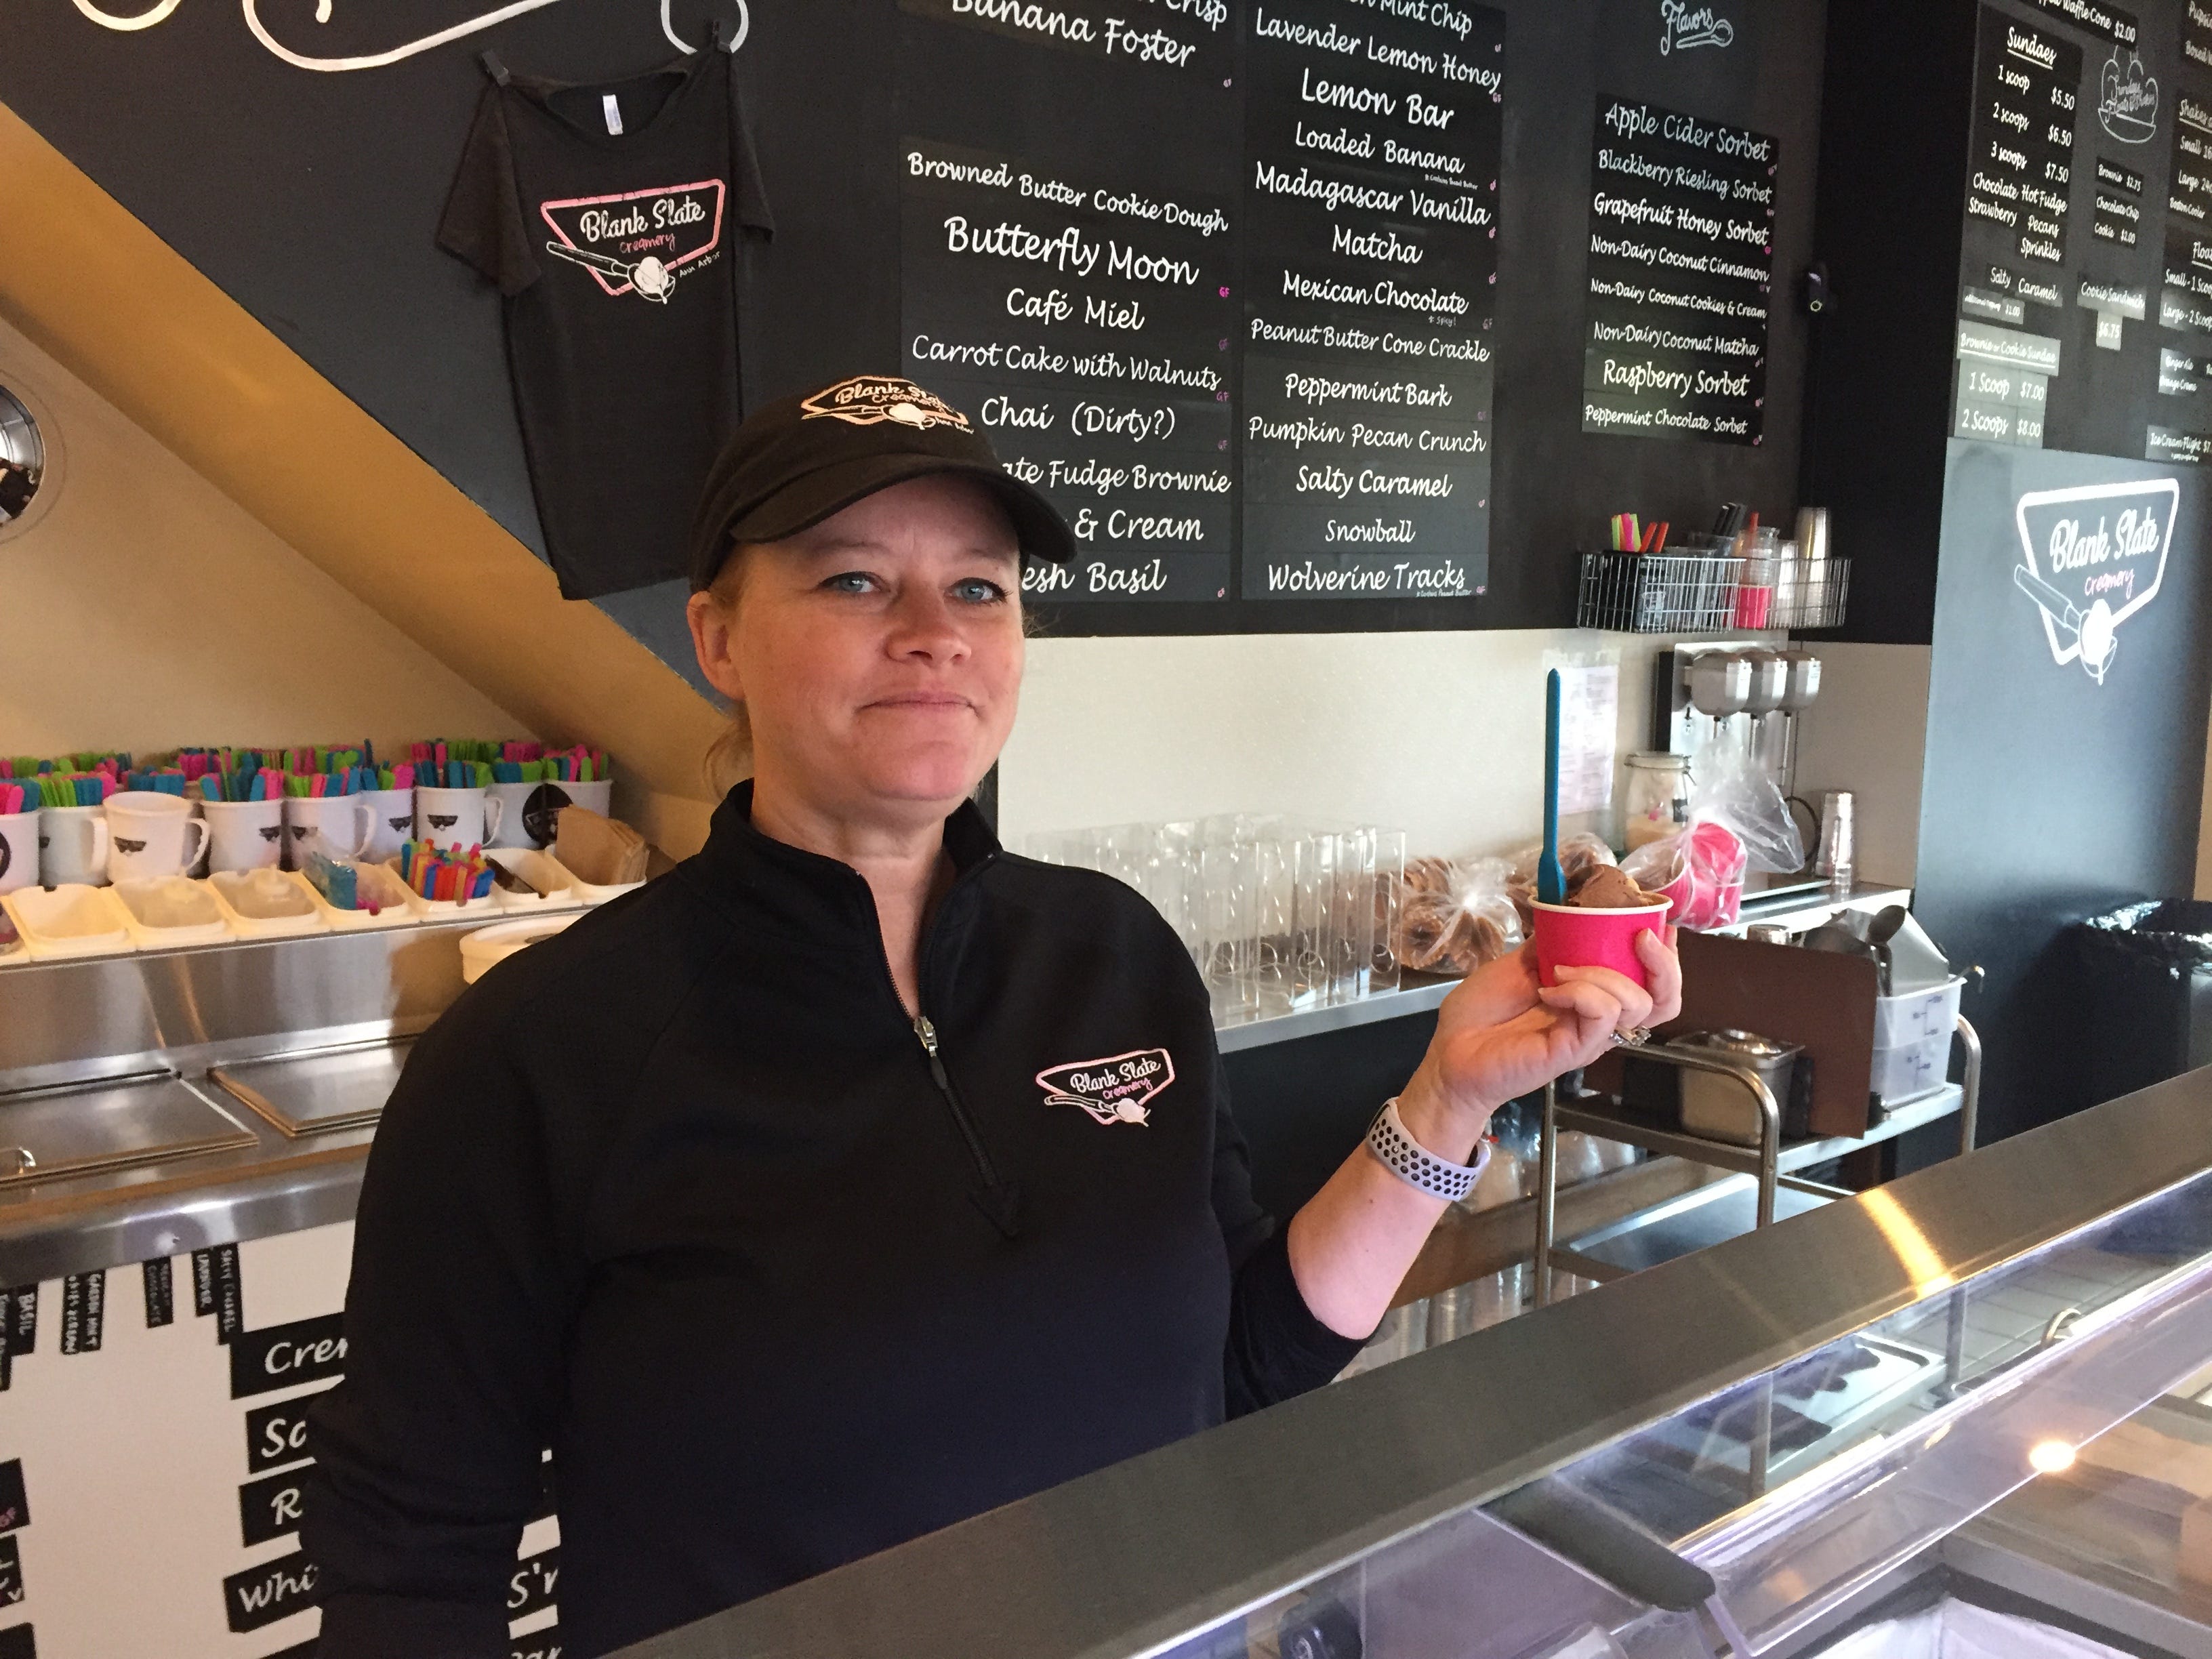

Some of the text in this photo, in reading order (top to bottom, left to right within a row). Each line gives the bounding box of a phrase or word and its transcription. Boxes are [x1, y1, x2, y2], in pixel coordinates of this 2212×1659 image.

[954, 0, 1195, 66] Banana Foster
[1431, 3, 1472, 41] Chip
[1660, 0, 1713, 56] Flavors
[2090, 7, 2112, 30] Cone
[2114, 20, 2135, 43] $2.00
[1256, 7, 1501, 94] Lavender Lemon Honey
[2007, 26, 2057, 64] Sundaes
[1302, 68, 1454, 129] Lemon Bar
[1998, 65, 2004, 81] 1
[2005, 70, 2030, 96] scoop
[2051, 86, 2075, 111] $5.50
[1605, 102, 1771, 162] Apple Cider Sorbet
[1993, 102, 2072, 147] 2 scoops $6.50
[1296, 121, 1465, 174] Loaded Banana
[1990, 142, 2068, 184] 3 scoops $7.50
[2180, 136, 2202, 155] Small
[907, 152, 1228, 237] Browned Butter Cookie Dough
[1256, 161, 1491, 226] Madagascar Vanilla
[1598, 149, 1773, 204] Blackberry Riesling Sorbet
[1973, 172, 2068, 217] Chocolate Hot Fudge
[2178, 169, 2199, 192] Large
[580, 194, 705, 243] Blank Slate
[1594, 192, 1770, 246] Grapefruit Honey Sorbet
[1968, 197, 2060, 239] Strawberry Pecans
[619, 232, 676, 254] creamery
[945, 216, 1199, 285] Butterfly Moon
[1332, 224, 1423, 264] Matcha
[1591, 234, 1769, 283] Non-Dairy Coconut Cinnamon
[2020, 237, 2062, 262] Sprinkles
[1283, 270, 1469, 315] Mexican Chocolate
[1990, 267, 2059, 301] Salty Caramel
[2081, 281, 2108, 302] Cookie
[2165, 268, 2186, 287] Small
[1007, 287, 1145, 331] Café Miel
[1591, 278, 1767, 319] Non-Dairy Coconut Cookies & Cream
[2163, 302, 2184, 324] Large
[1251, 319, 1490, 363] Peanut Butter Cone Crackle
[1594, 321, 1759, 359] Non-Dairy Coconut Matcha
[1961, 333, 1992, 351] Brownie
[2001, 342, 2026, 357] Cookie
[913, 335, 1221, 392] Carrot Cake with Walnuts
[1603, 359, 1750, 398] Raspberry Sorbet
[835, 383, 905, 405] Blank
[1216, 392, 1229, 401] GF
[1286, 373, 1452, 407] Peppermint Bark
[1969, 372, 2045, 401] 1 Scoop $7.00
[981, 396, 1054, 429] Chai
[1071, 402, 1176, 443] (Dirty?)
[1249, 416, 1487, 453] Pumpkin Pecan Crunch
[1585, 405, 1748, 435] Peppermint Chocolate Sorbet
[1961, 409, 2041, 438] 2 Scoops $8.00
[1049, 459, 1128, 495] Fudge
[1132, 464, 1231, 493] Brownie
[1296, 466, 1453, 499] Salty Caramel
[1074, 508, 1204, 541] & Cream
[1325, 518, 1416, 543] Snowball
[2050, 506, 2159, 573] Blank Slate
[1022, 559, 1167, 593] esh Basil
[1268, 559, 1465, 591] Wolverine Tracks
[1070, 1058, 1161, 1093] Blank Slate
[1103, 1078, 1153, 1099] creamery
